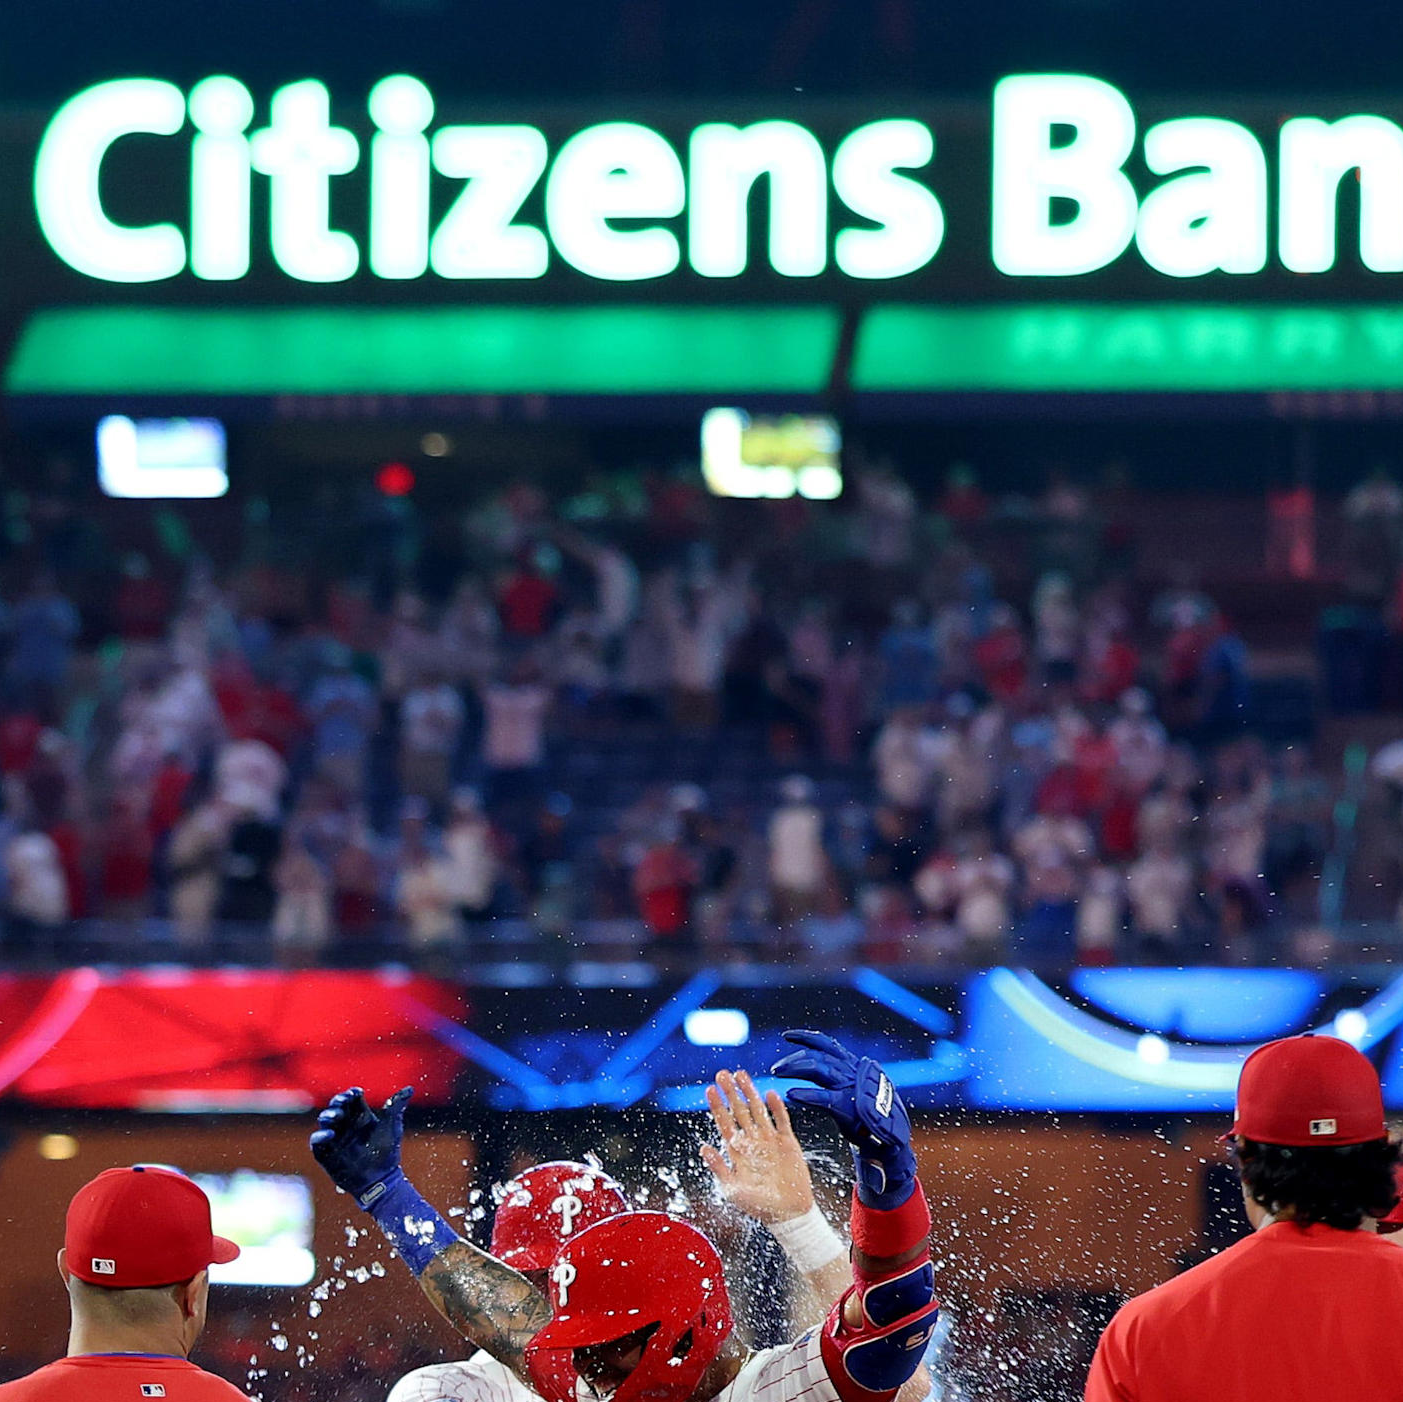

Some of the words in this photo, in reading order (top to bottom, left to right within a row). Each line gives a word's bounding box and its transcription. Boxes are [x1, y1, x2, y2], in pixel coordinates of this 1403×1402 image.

[33, 73, 945, 284] Citizens
[552, 1194, 583, 1236] P
[552, 1263, 577, 1307] P
